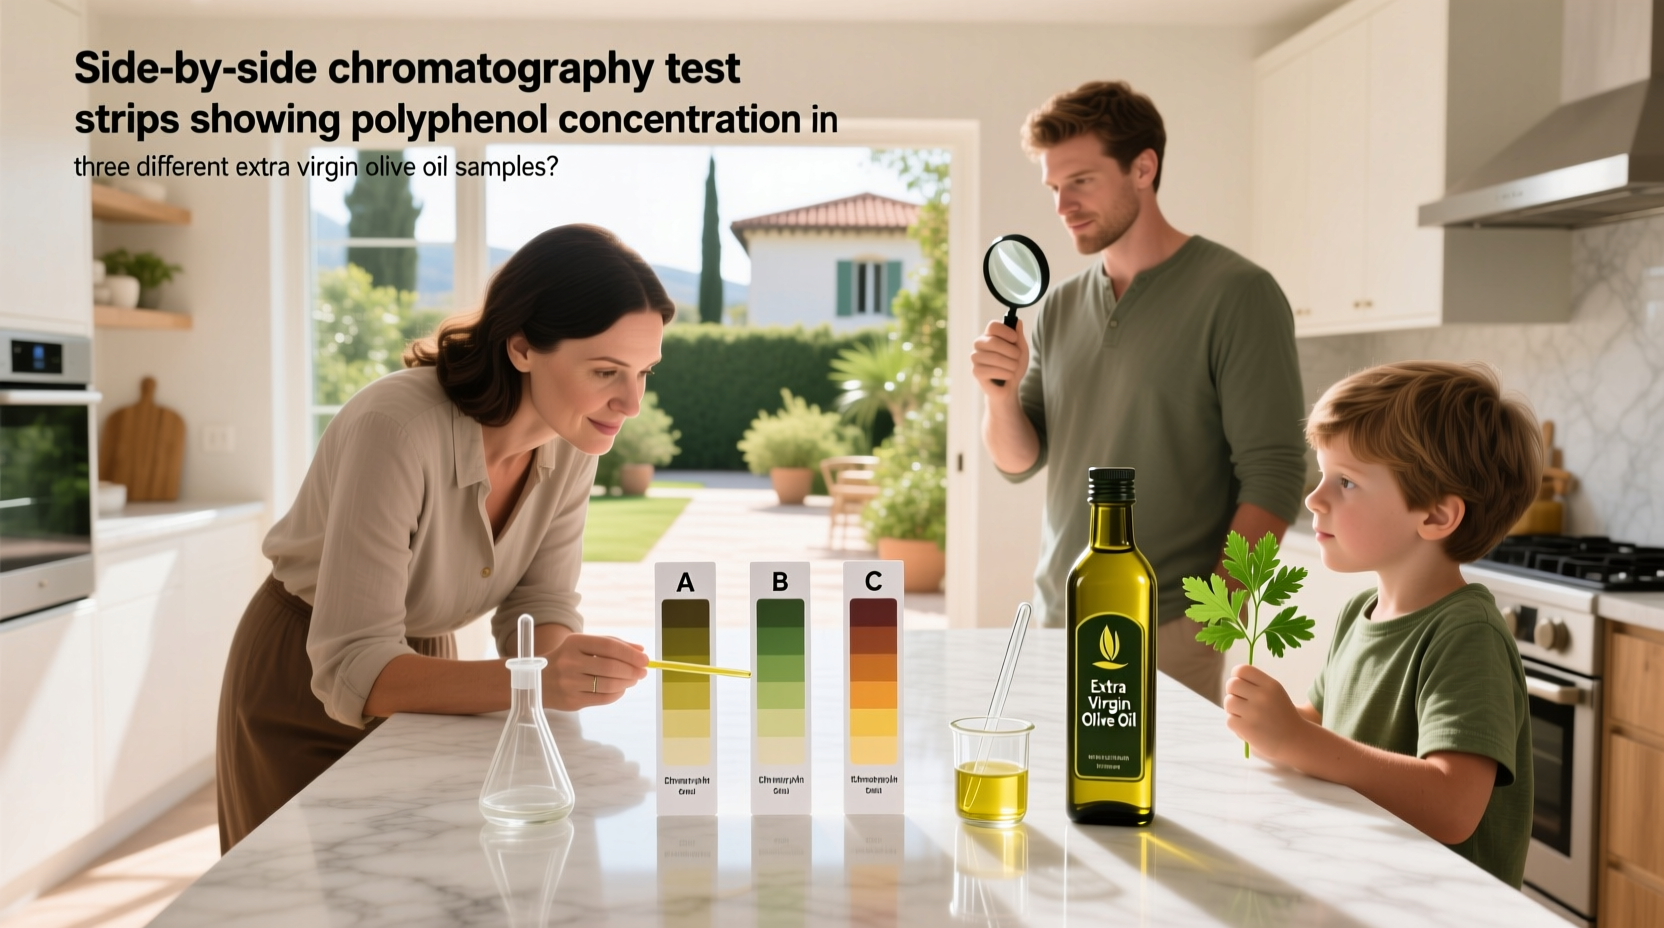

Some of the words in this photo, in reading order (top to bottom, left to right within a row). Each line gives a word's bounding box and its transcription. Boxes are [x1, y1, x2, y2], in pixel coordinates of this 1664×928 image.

[676, 571, 695, 593] A
[772, 571, 789, 592] B
[865, 570, 883, 592] C
[1091, 679, 1126, 694] Extra
[1087, 695, 1131, 714] Virgin
[1081, 712, 1115, 728] Olive
[1117, 712, 1137, 728] Oil
